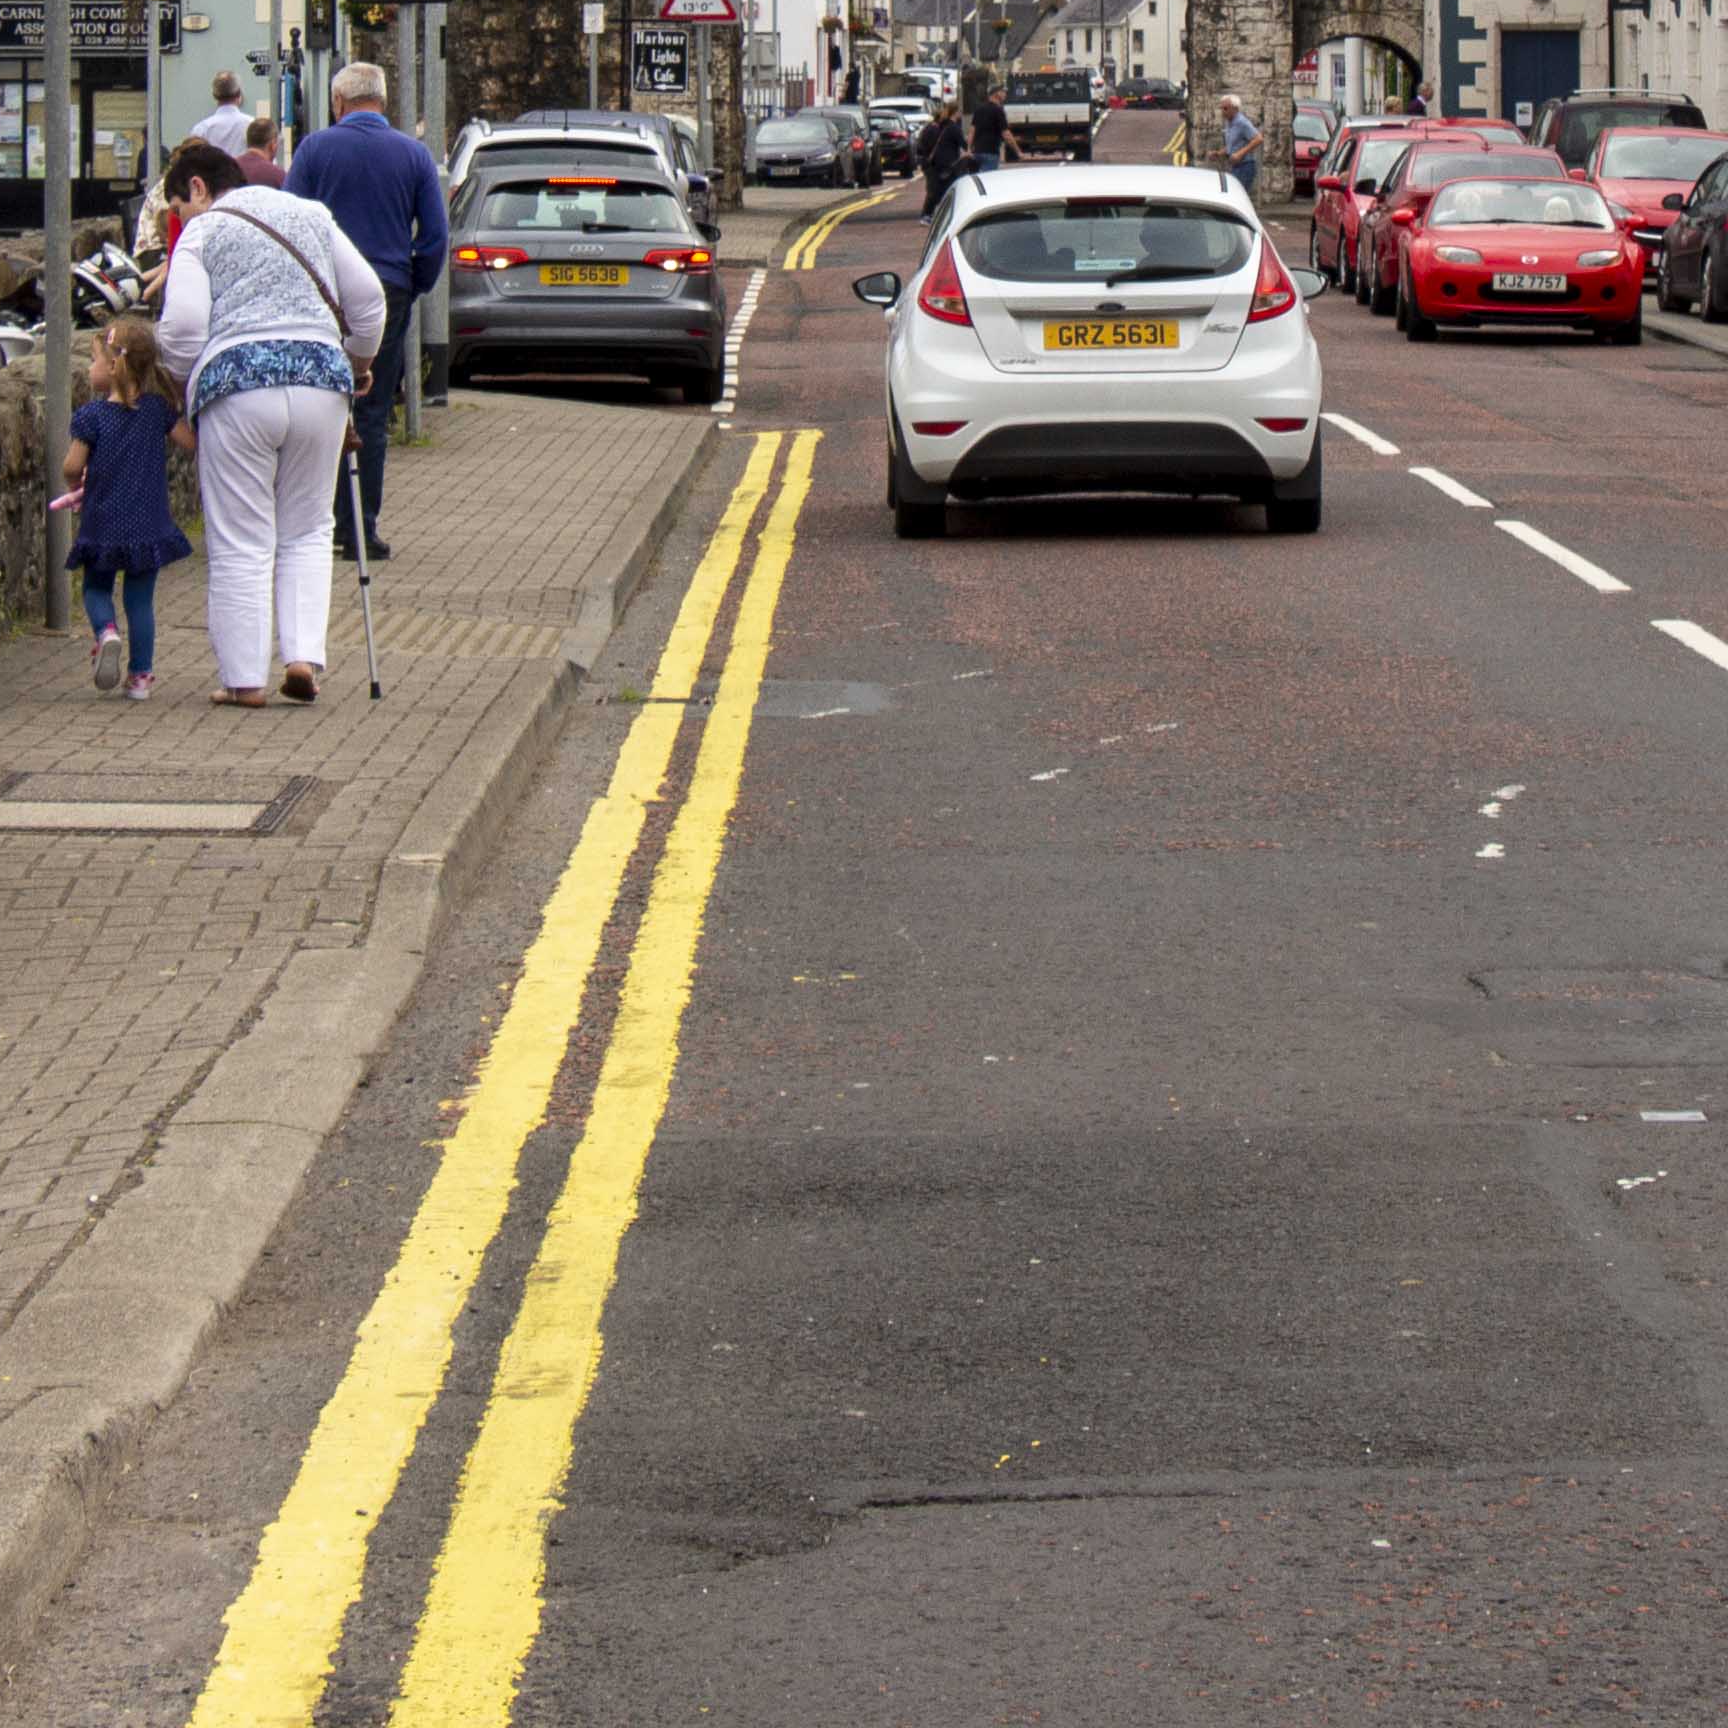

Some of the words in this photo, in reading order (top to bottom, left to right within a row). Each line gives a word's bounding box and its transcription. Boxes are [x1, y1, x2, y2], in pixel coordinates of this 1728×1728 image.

[636, 31, 685, 45] Harbour
[651, 49, 681, 64] Lights
[1499, 275, 1524, 288] KJZ
[1528, 275, 1562, 288] 7757
[1058, 324, 1104, 347] GRZ
[1112, 324, 1165, 347] 5631
